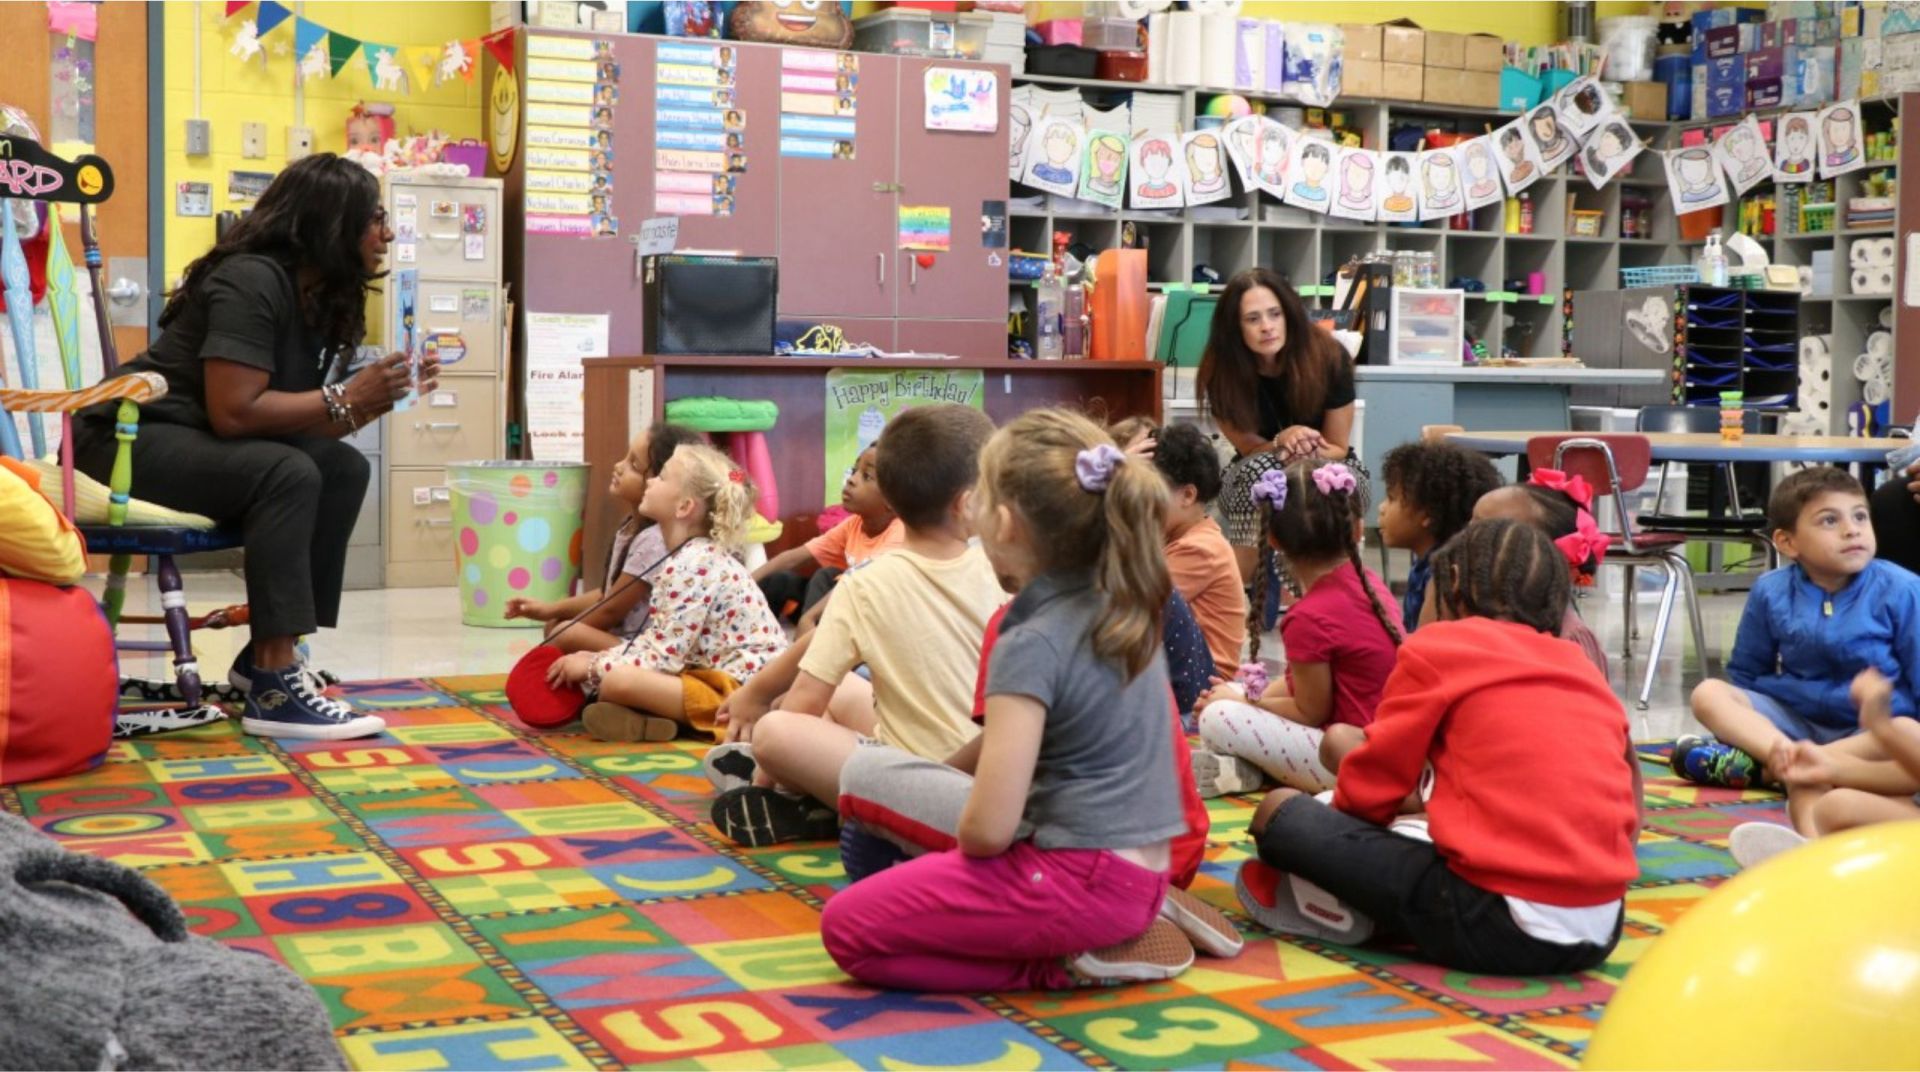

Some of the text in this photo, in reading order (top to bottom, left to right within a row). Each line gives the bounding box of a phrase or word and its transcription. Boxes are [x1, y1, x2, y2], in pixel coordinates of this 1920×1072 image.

[530, 369, 585, 380] Fire Alar
[832, 379, 889, 410] Happy
